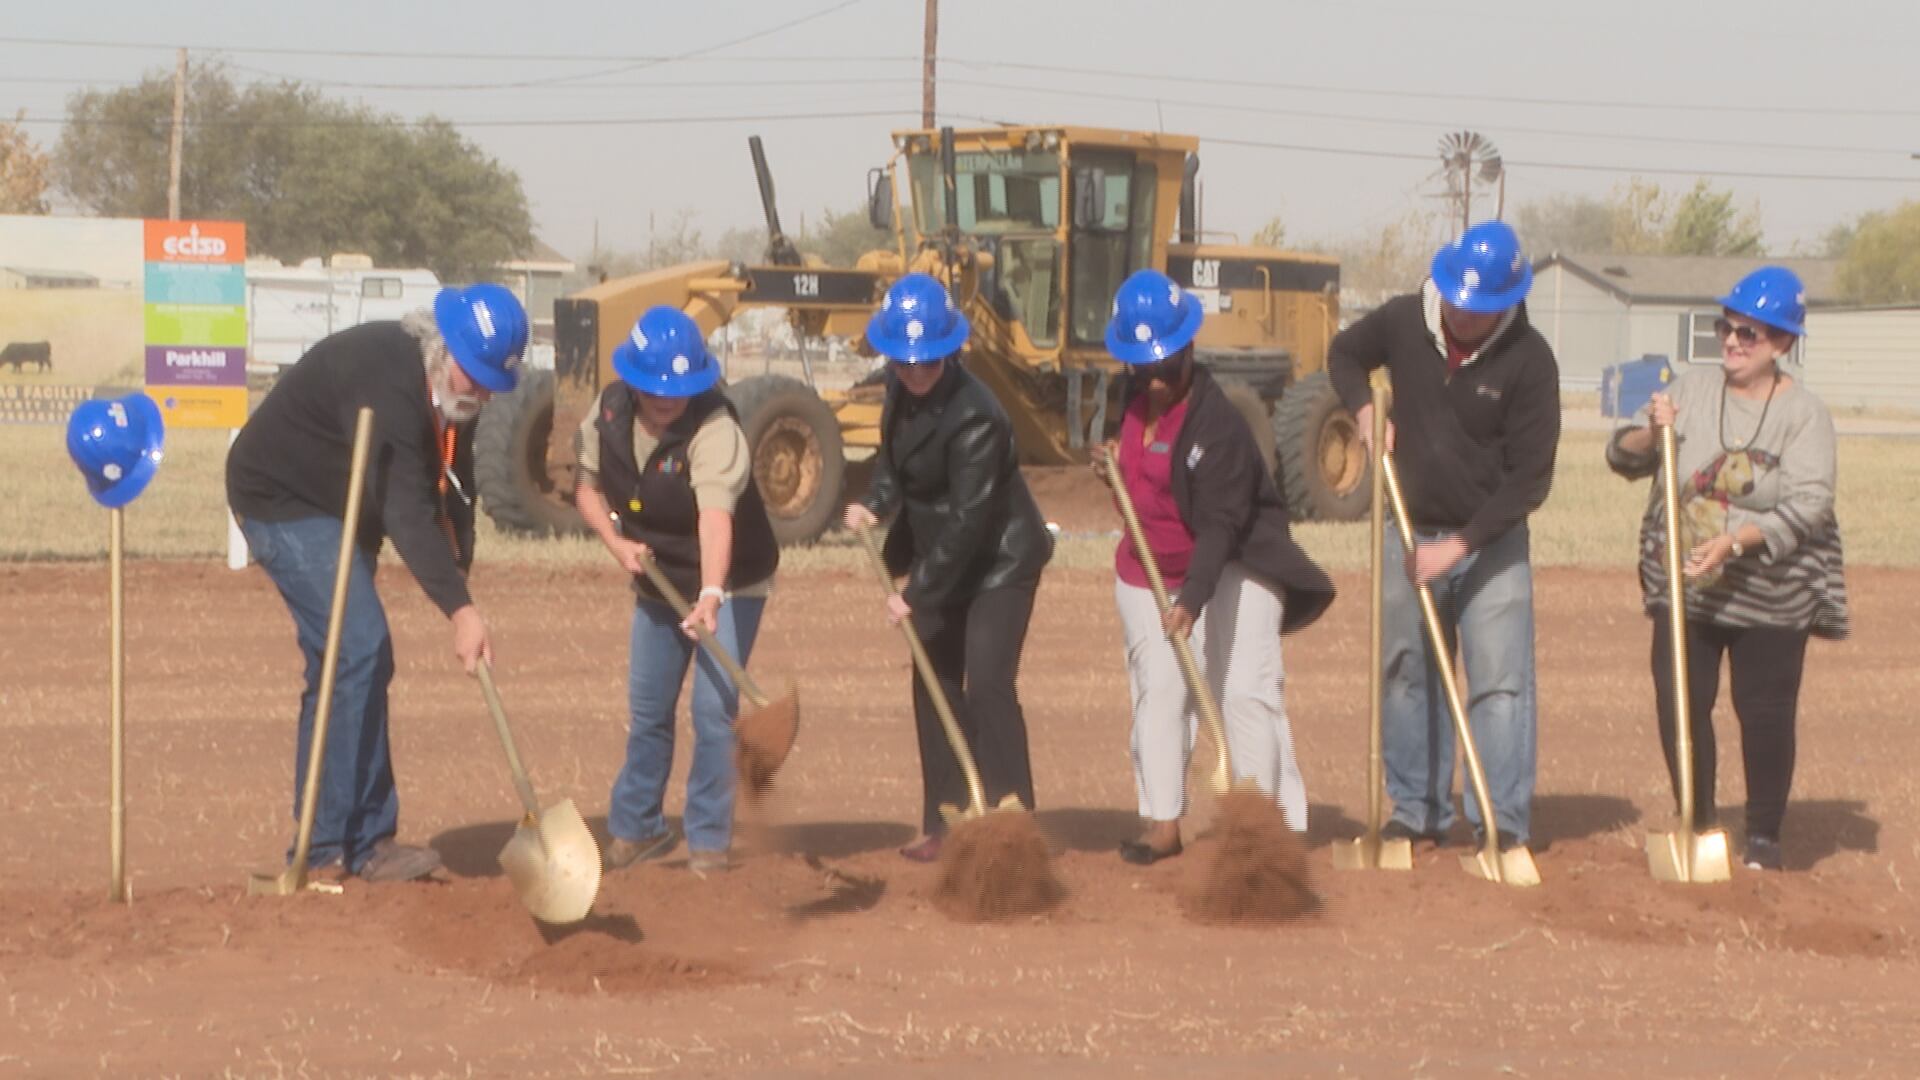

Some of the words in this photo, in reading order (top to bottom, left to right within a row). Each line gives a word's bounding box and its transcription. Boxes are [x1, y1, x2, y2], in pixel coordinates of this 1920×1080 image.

[1193, 259, 1220, 287] CAT
[793, 273, 819, 296] 12H
[166, 350, 226, 368] Parkhill
[23, 385, 95, 401] FACILITY
